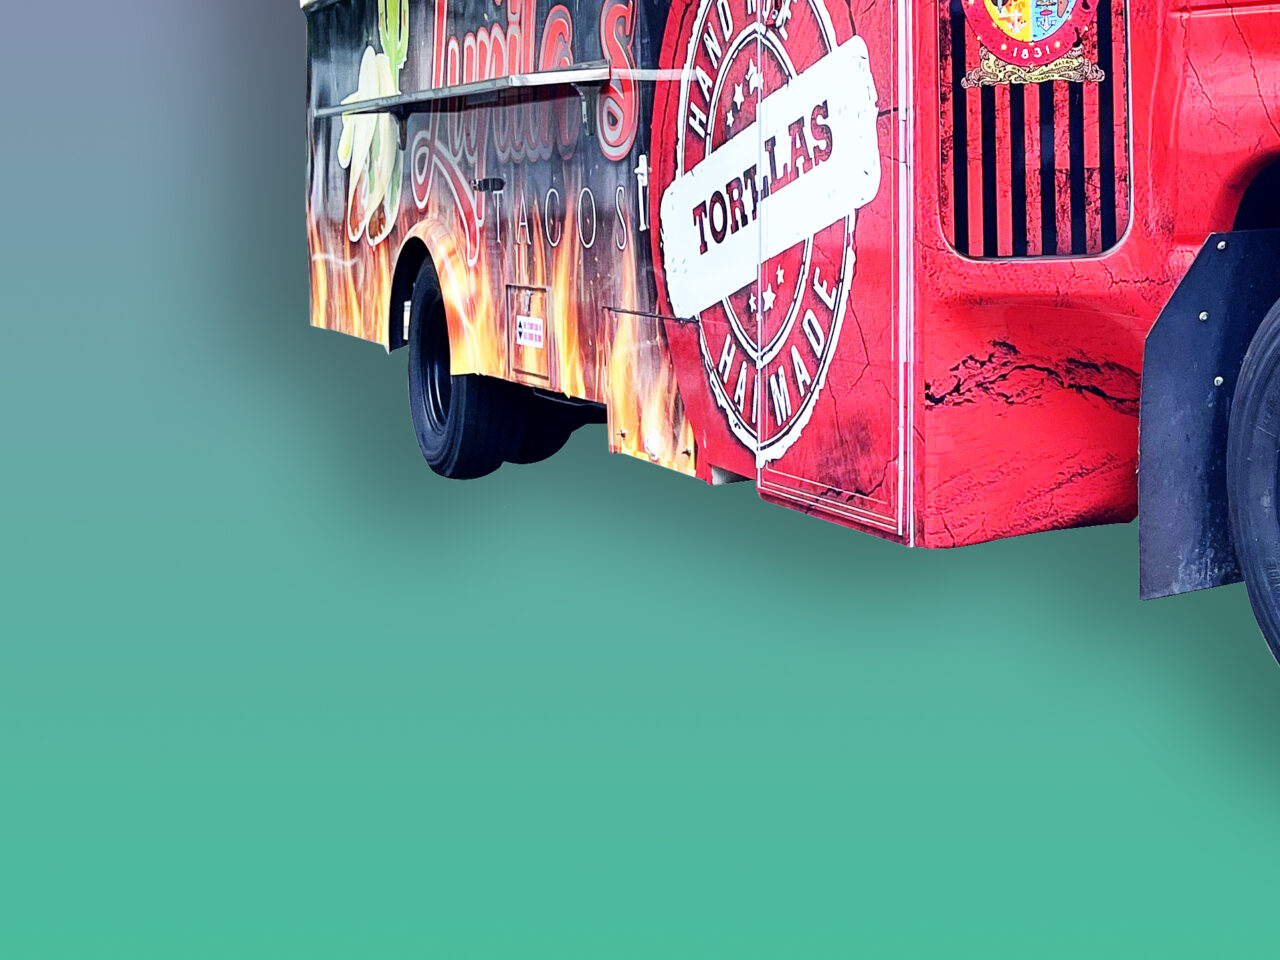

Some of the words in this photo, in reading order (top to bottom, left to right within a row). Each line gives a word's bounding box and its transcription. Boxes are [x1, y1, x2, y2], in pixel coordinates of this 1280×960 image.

[1012, 45, 1051, 59] 1831
[492, 187, 628, 250] TACOS
[692, 100, 833, 256] TORTLAS
[718, 333, 759, 424] HA
[770, 266, 838, 427] MADE
